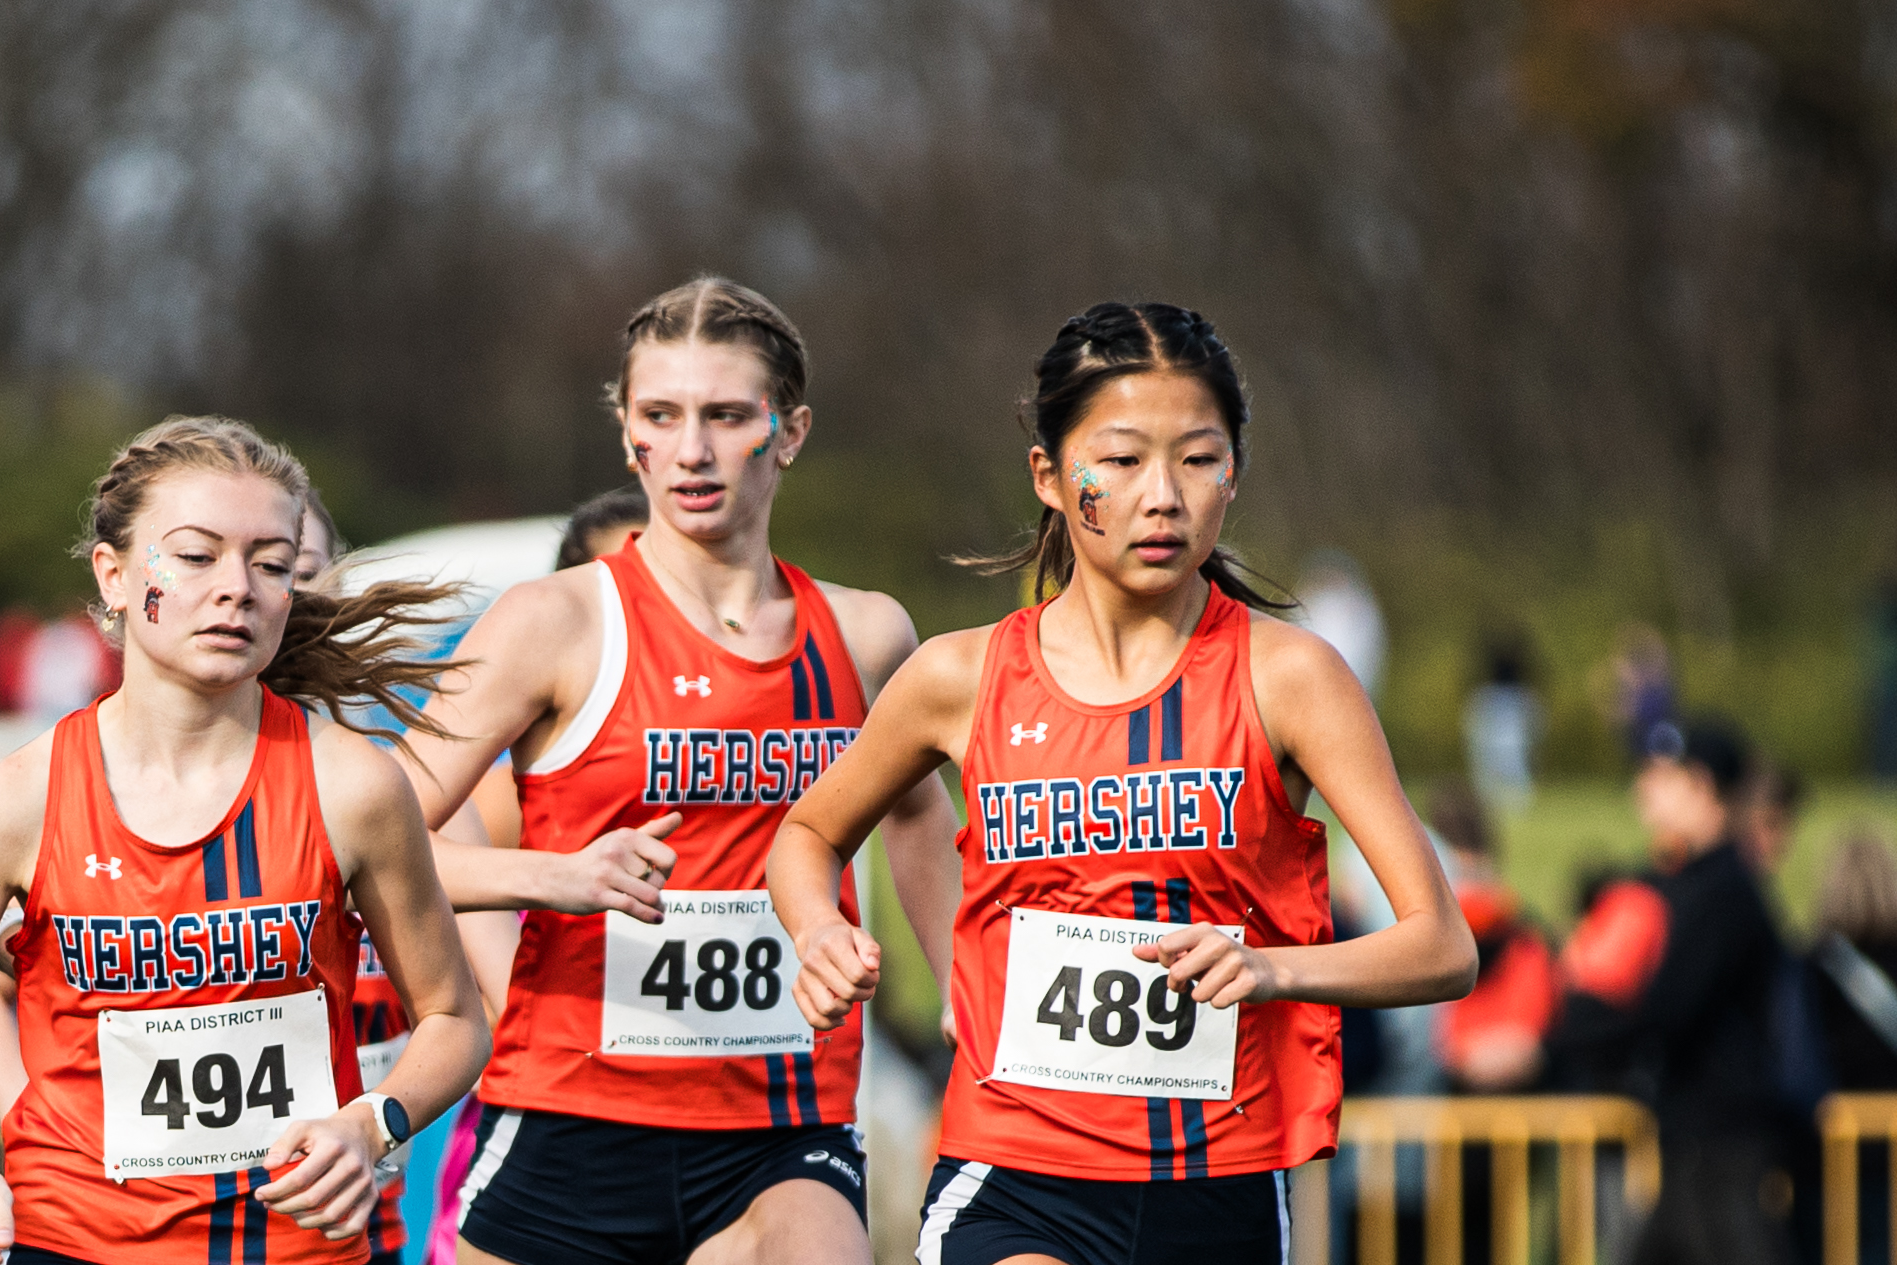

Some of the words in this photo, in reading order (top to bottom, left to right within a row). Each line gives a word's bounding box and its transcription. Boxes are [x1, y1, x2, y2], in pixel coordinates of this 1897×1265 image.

[978, 767, 1244, 864] HERSHEY
[664, 901, 696, 914] IAA
[702, 900, 768, 914] DISTRICT
[1056, 924, 1094, 941] PIAA
[51, 899, 321, 993] HERSHEY
[641, 936, 783, 1012] 488
[146, 1019, 185, 1033] PIAA
[191, 1009, 265, 1031] DISTRICT
[269, 1007, 283, 1020] III
[1036, 965, 1197, 1051] 489
[619, 1034, 660, 1046] CROSS
[664, 1035, 720, 1047] COUNTRY
[723, 1034, 803, 1046] CHAMPIONSHIPS
[141, 1043, 295, 1130] 494
[1011, 1064, 1051, 1077] CROSS
[1055, 1068, 1113, 1083] COUNTRY
[1117, 1075, 1218, 1090] CHAMPIONSHIPS
[122, 1157, 164, 1168] CROSS
[168, 1153, 227, 1166] COUNTRY
